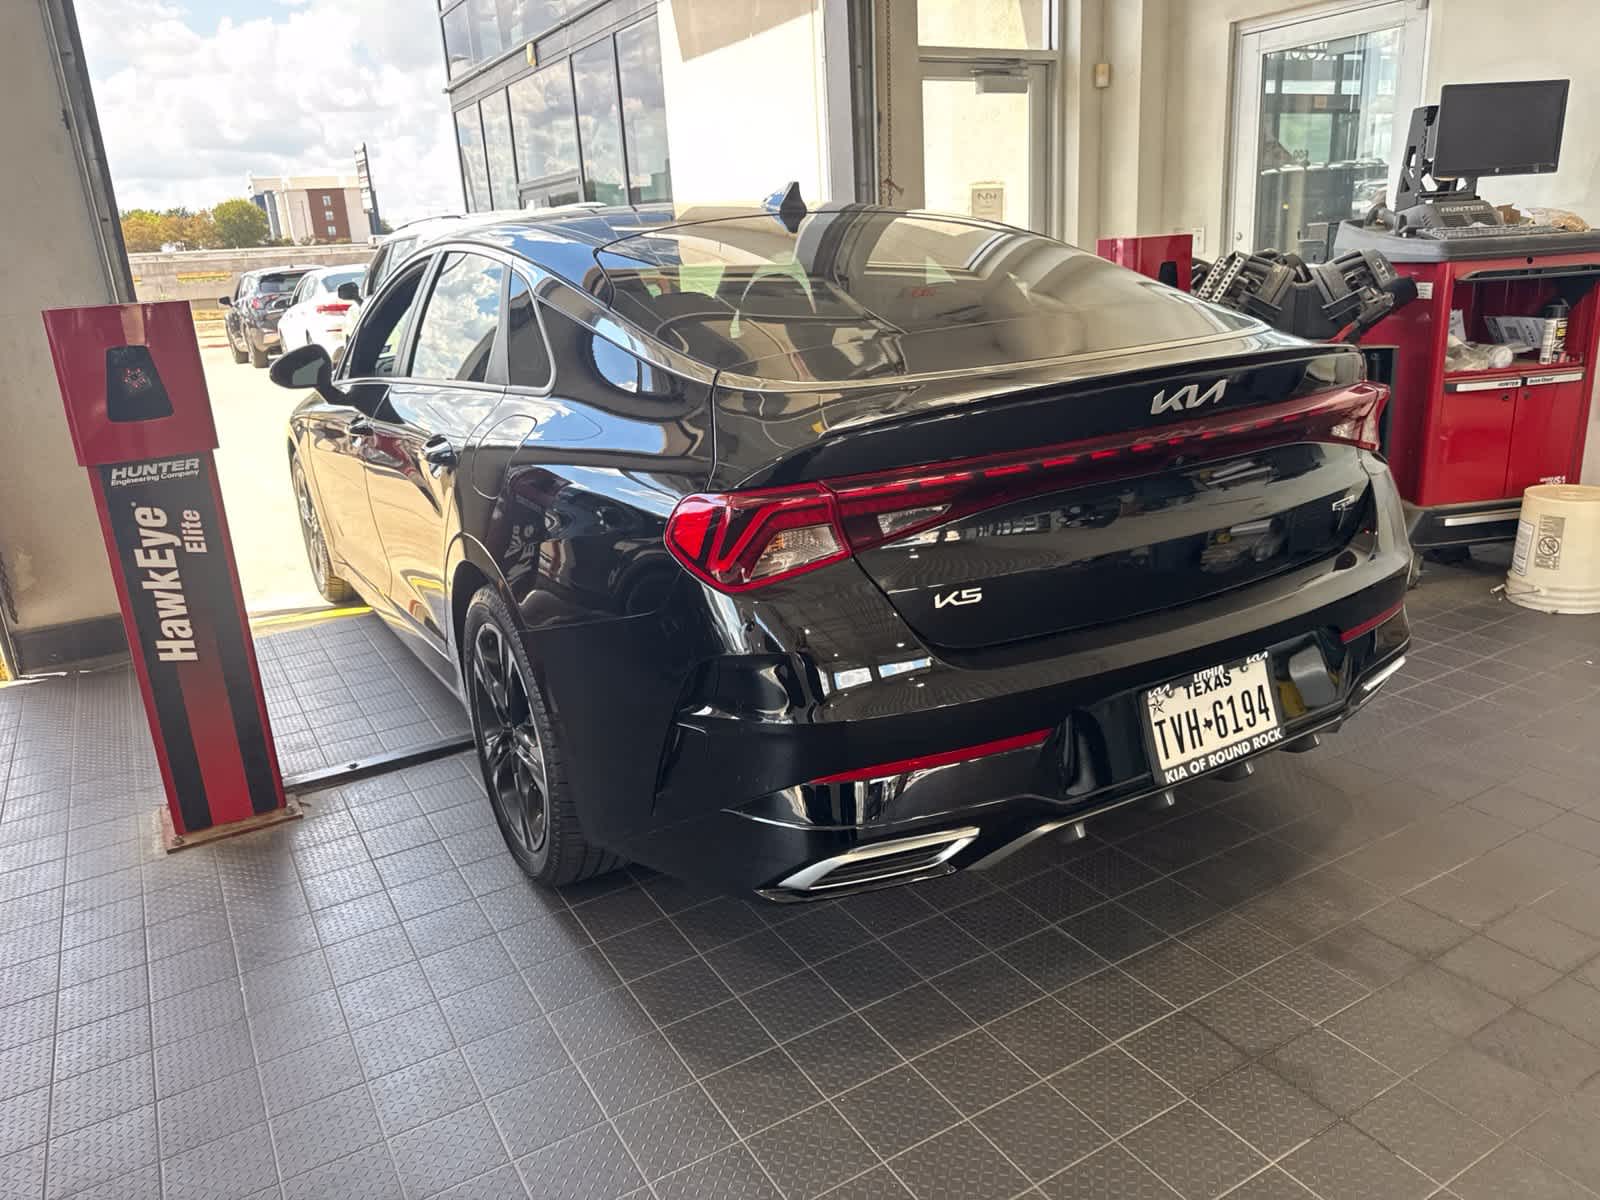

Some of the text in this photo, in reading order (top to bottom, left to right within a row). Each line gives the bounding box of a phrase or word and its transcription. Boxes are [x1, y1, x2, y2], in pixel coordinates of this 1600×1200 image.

[1150, 379, 1228, 415] KIA
[111, 470, 200, 487] Engineering Company
[112, 458, 200, 479] HUNTER
[181, 509, 208, 553] Elite
[134, 506, 199, 661] HawkEye
[934, 587, 983, 608] K5
[1184, 671, 1232, 699] TEXAS
[1164, 727, 1283, 783] KIA OF ROUND ROCK
